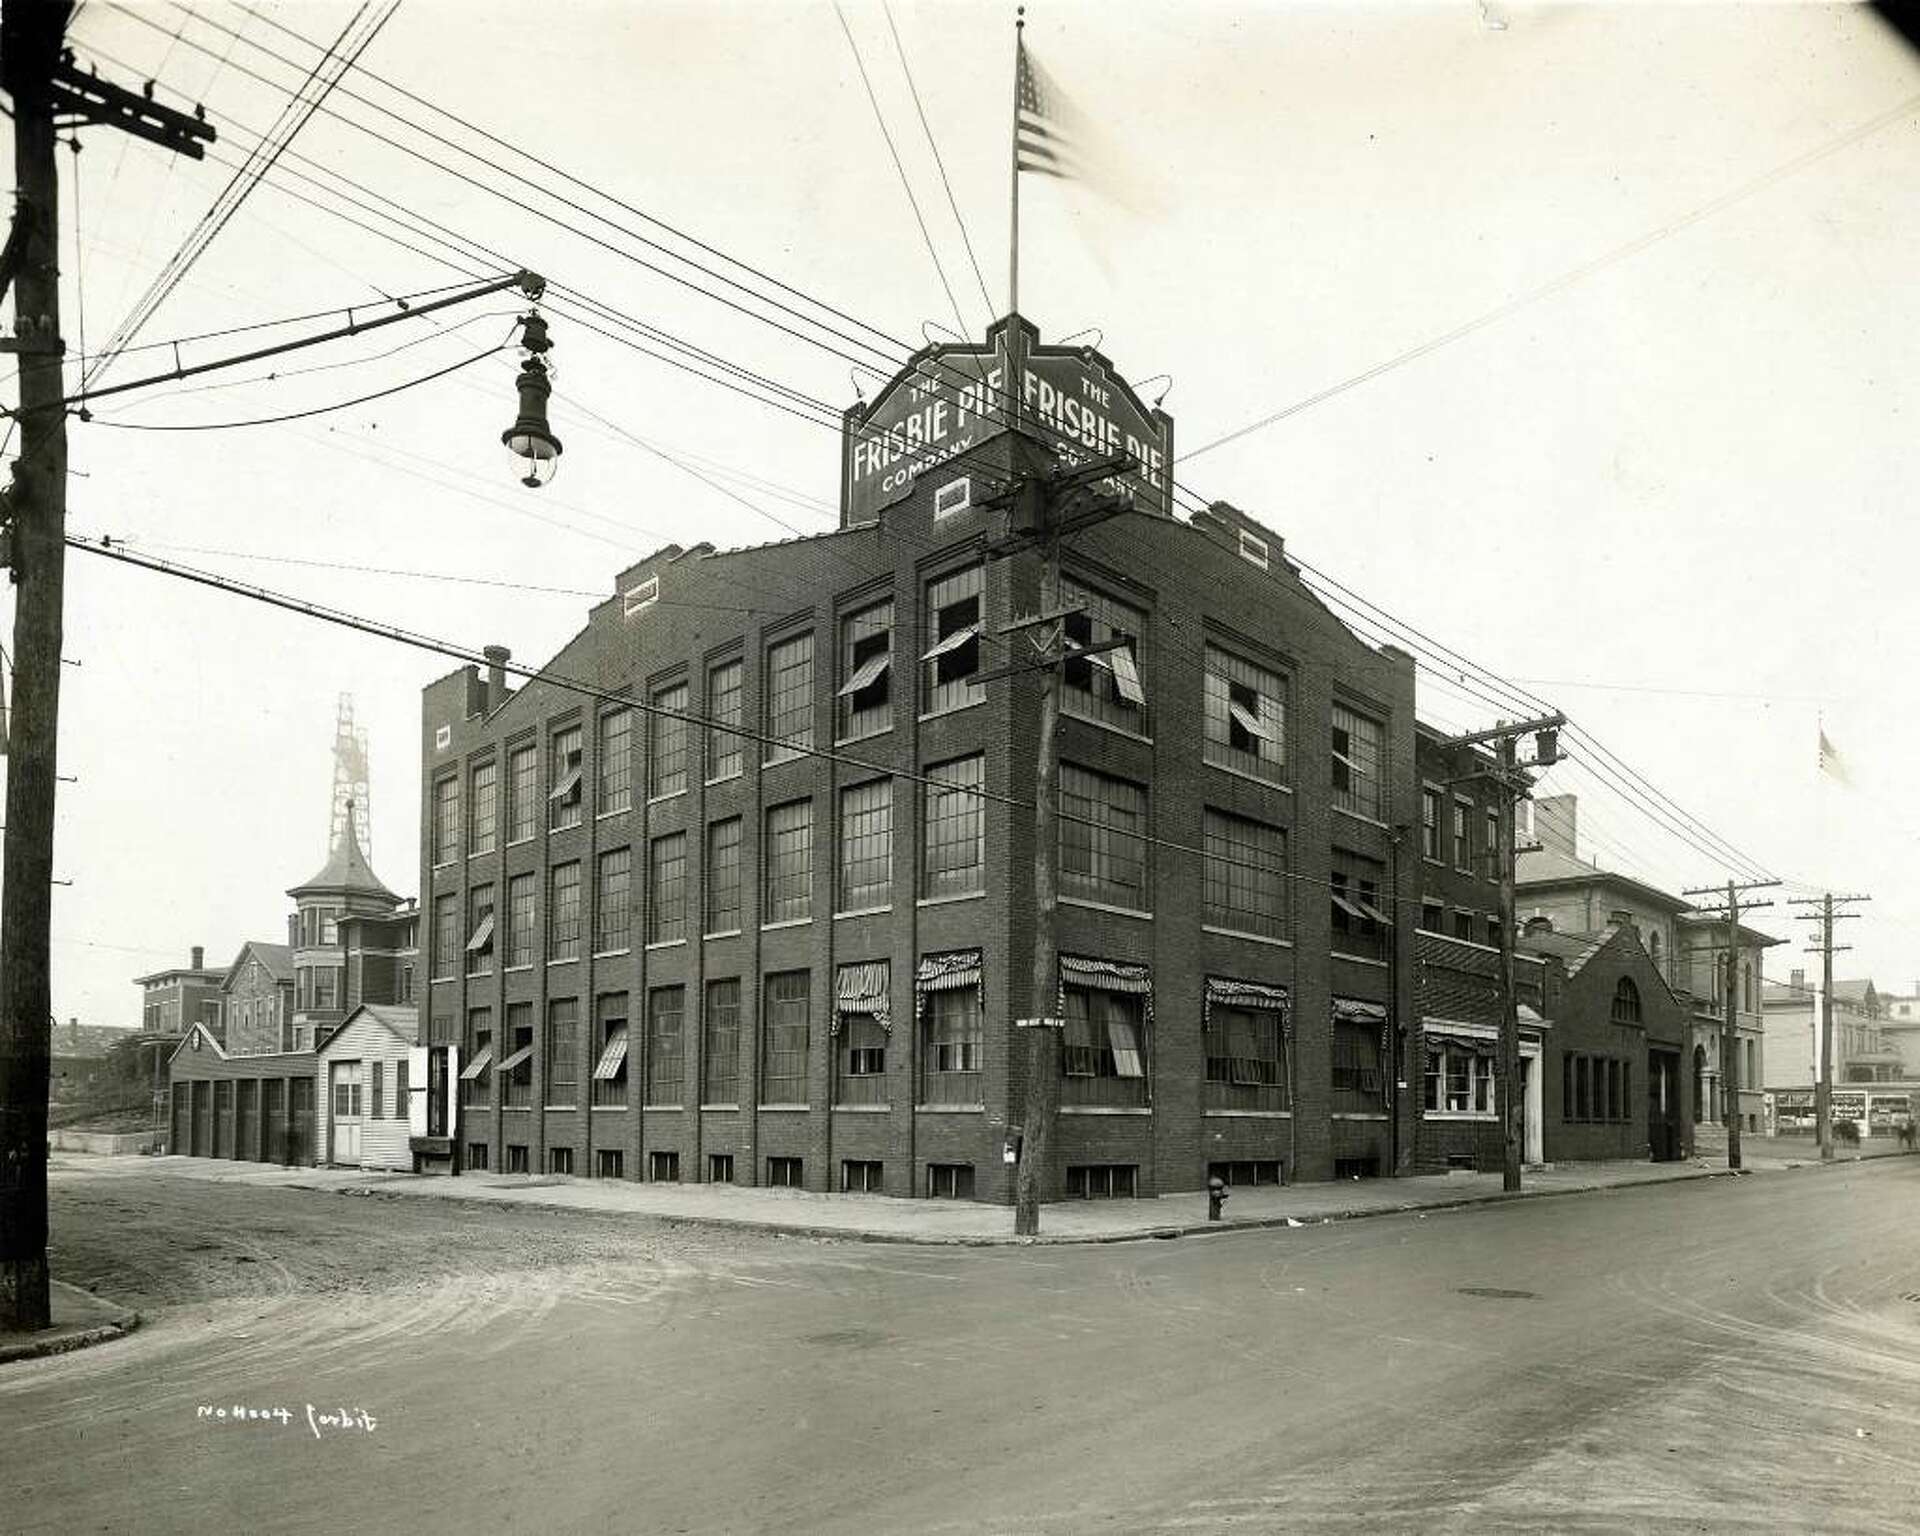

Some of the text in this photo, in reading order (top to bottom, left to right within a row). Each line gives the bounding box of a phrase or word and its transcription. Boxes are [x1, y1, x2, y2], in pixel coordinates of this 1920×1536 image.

[854, 366, 1003, 482] FRISBIE PIE
[908, 372, 943, 403] THE
[1081, 376, 1111, 409] THE
[1023, 369, 1162, 489] FRISBIE PIE
